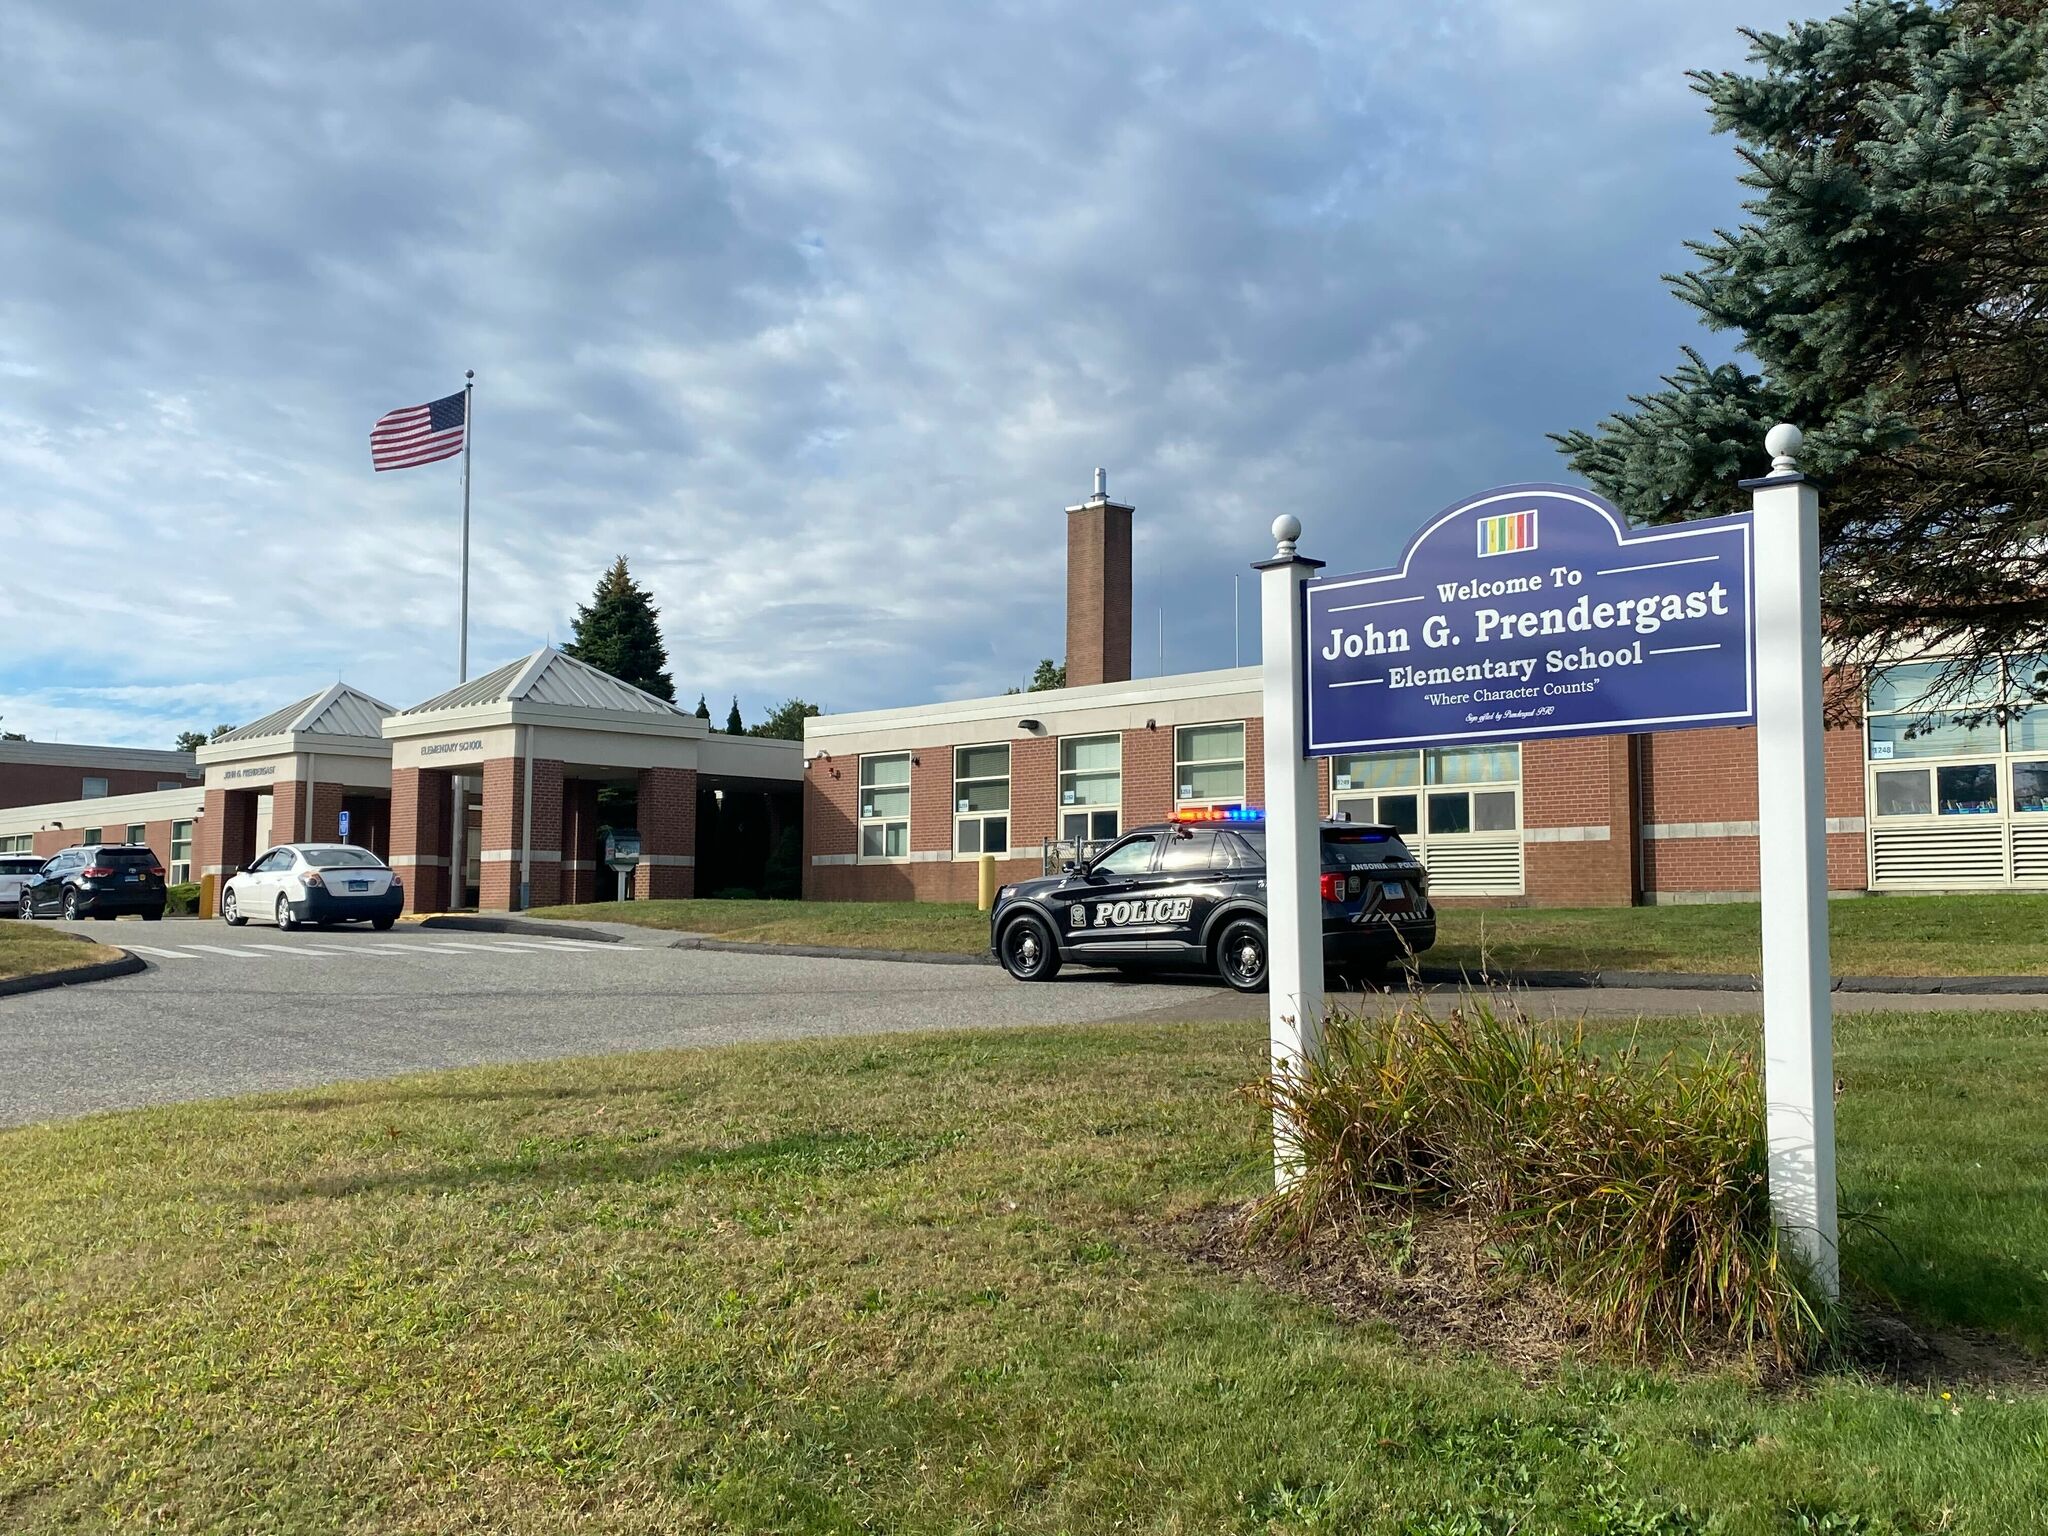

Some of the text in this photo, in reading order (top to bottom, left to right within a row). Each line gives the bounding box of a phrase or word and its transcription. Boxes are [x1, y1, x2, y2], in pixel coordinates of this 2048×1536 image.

[1437, 566, 1582, 603] Welcome To
[1322, 581, 1729, 661] John G. Prendergast
[1388, 640, 1643, 689] Elementary School
[1424, 678, 1600, 706] “Where Character Counts”
[1495, 712, 1503, 721] by
[420, 740, 483, 755] ELEMENTARY SCHOOL
[1351, 863, 1389, 871] ANSONIA
[1057, 879, 1067, 889] 2
[1094, 898, 1194, 927] POLICE
